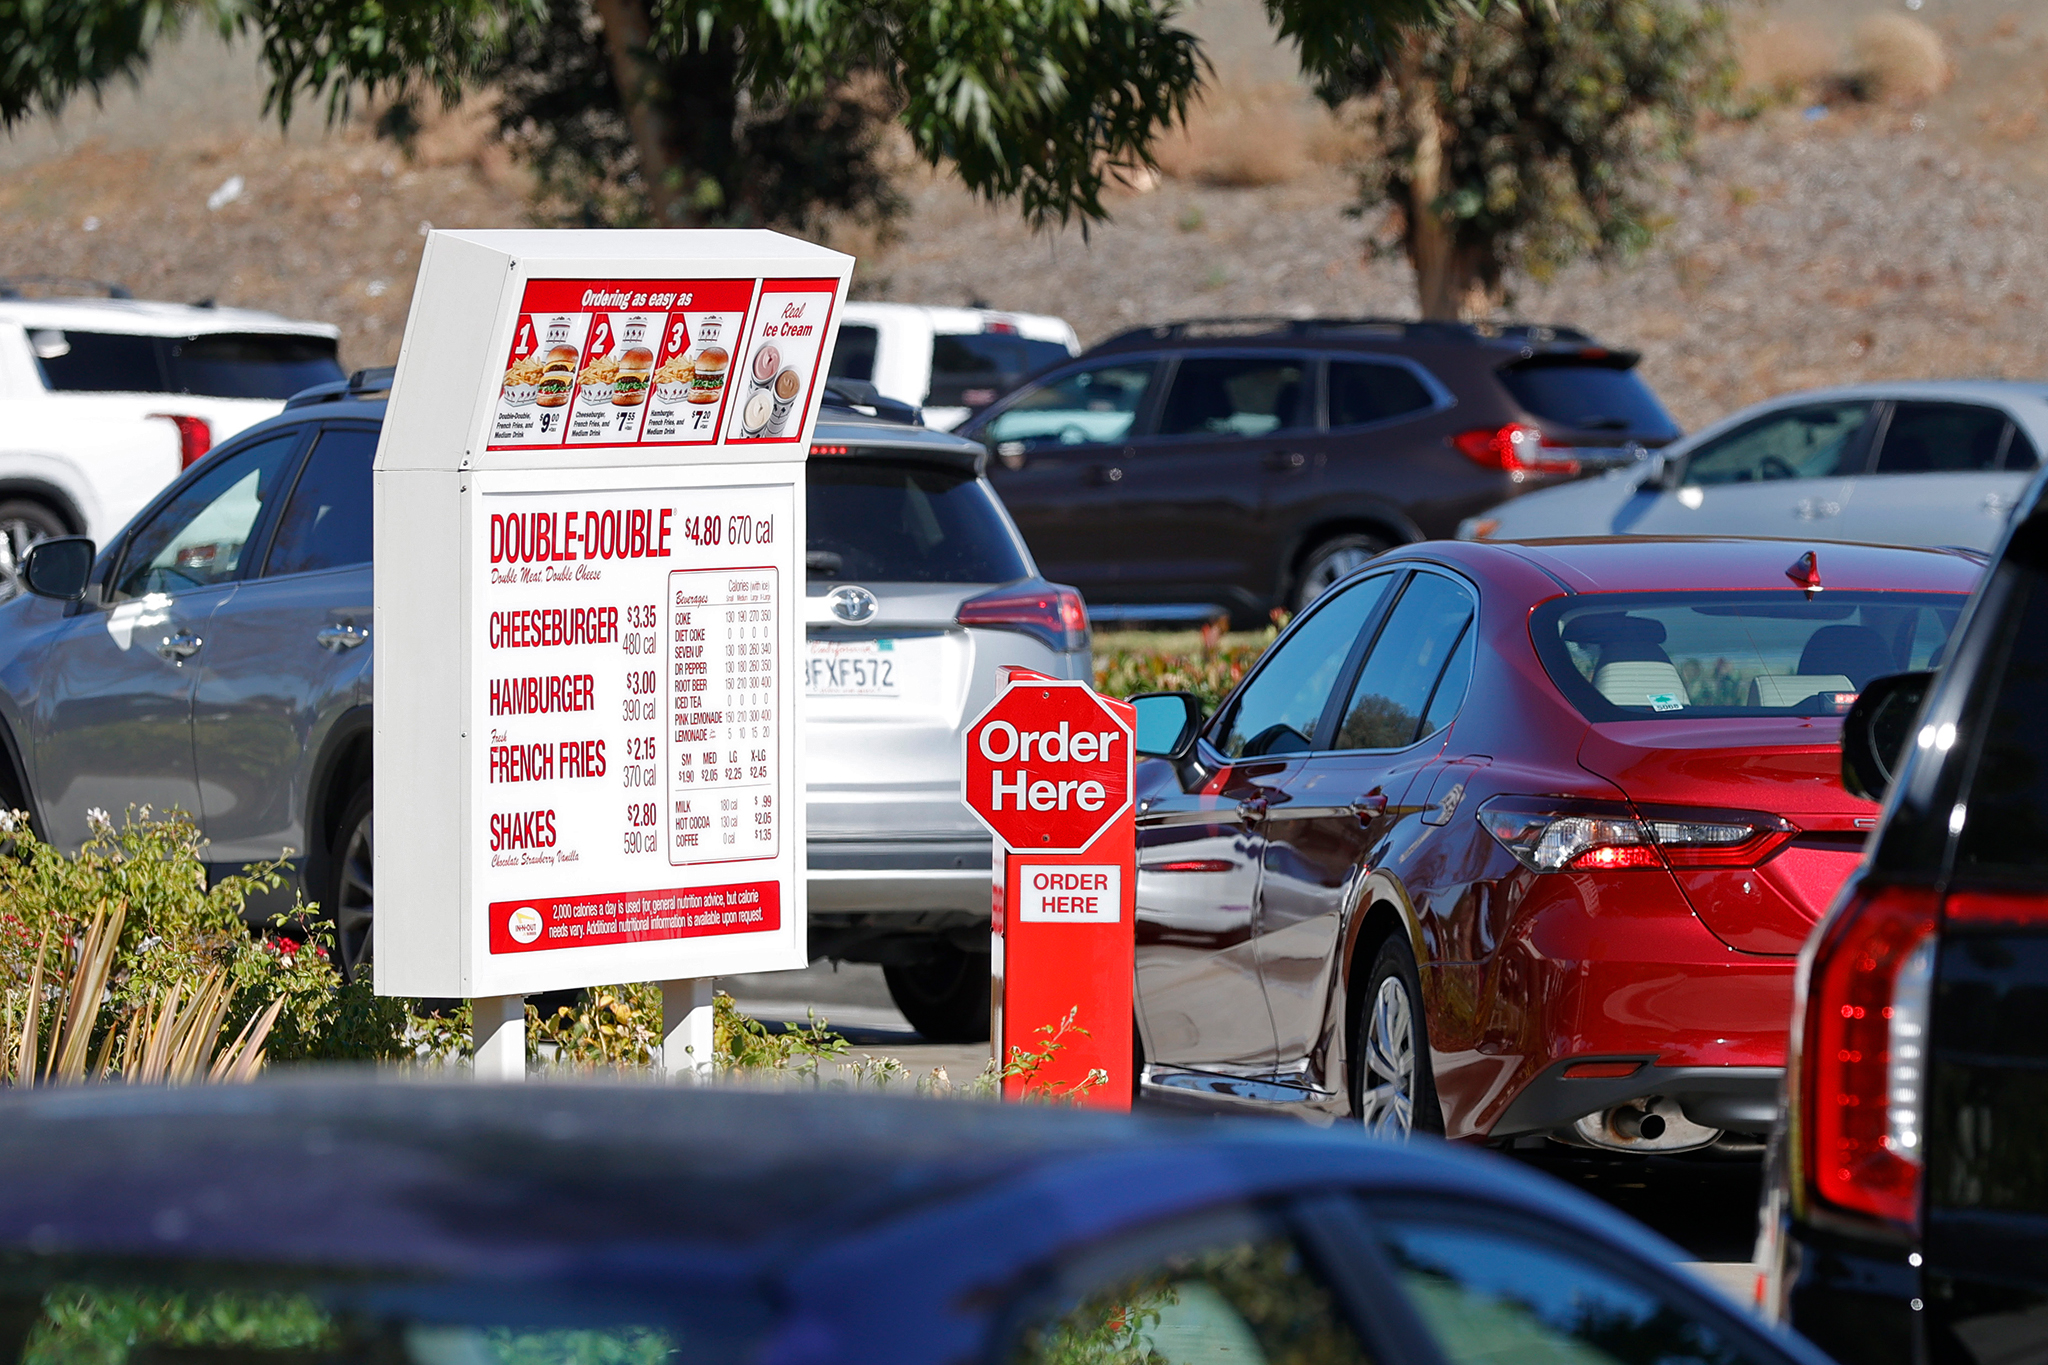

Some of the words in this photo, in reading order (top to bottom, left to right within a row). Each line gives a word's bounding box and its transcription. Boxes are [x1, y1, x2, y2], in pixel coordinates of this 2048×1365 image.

[581, 289, 633, 310] Ordering
[631, 293, 647, 306] as
[648, 293, 677, 310] easy
[677, 293, 693, 306] as
[781, 302, 806, 319] Real
[515, 323, 531, 354] 1
[590, 322, 609, 353] 2
[667, 322, 684, 353] 3
[762, 322, 778, 337] Ice
[780, 322, 813, 337] Cream
[575, 411, 605, 419] Cheeseburger,
[650, 410, 674, 418] Hamburger,
[512, 422, 524, 430] Fries,
[490, 508, 672, 563] DOUBLE-DOUBLE
[685, 515, 721, 546] $4.80
[728, 515, 752, 545] 670
[755, 514, 773, 544] cal
[491, 568, 517, 584] Double
[546, 565, 573, 582] Double
[575, 564, 601, 581] Cheese
[728, 579, 749, 592] Calories
[676, 590, 708, 608] Beverages
[675, 612, 691, 625] COKE
[749, 610, 759, 622] 270
[761, 609, 771, 621] 350
[490, 606, 618, 649] CHEESEBURGER
[627, 605, 656, 628] $3.35
[675, 629, 688, 642] DIET
[689, 628, 705, 641] COKE
[622, 632, 641, 655] 480
[643, 632, 657, 654] cal
[675, 646, 694, 659] SEVEN
[695, 645, 703, 658] UP
[761, 643, 771, 655] 340
[675, 663, 683, 675] DR
[685, 662, 707, 675] PEPPER
[761, 659, 771, 671] 350
[490, 674, 594, 716] HAMBURGER
[627, 670, 656, 694] $3.00
[675, 679, 691, 692] ROOT
[692, 679, 707, 691] BEER
[749, 676, 759, 689] 300
[761, 676, 771, 688] 400
[622, 699, 640, 721] 390
[643, 697, 656, 720] cal
[675, 696, 688, 709] ICED
[689, 696, 702, 708] TEA
[675, 713, 688, 726] PINK
[690, 711, 722, 725] LEMONADE
[749, 710, 759, 722] 300
[761, 709, 771, 721] 400
[491, 729, 507, 744] Fresh
[675, 728, 707, 742] LEMONADE
[739, 727, 745, 739] 10
[763, 726, 770, 738] 20
[978, 720, 1119, 762] Order
[490, 743, 553, 783] FRENCH
[560, 739, 606, 779] FRIES
[627, 737, 656, 760] $2.15
[681, 753, 691, 766] SM
[703, 751, 717, 764] MED
[729, 750, 738, 763] LG
[751, 749, 766, 762] X-LG
[623, 765, 641, 788] 370
[643, 763, 656, 786] cal
[701, 768, 718, 781] $2.05
[725, 767, 742, 780] $2.25
[750, 766, 767, 778] $2.45
[991, 770, 1106, 812] Here
[675, 800, 691, 813] MILK
[490, 809, 556, 851] SHAKES
[628, 803, 656, 826] $2.80
[675, 817, 688, 830] HOT
[689, 816, 710, 829] COCOA
[754, 812, 772, 824] $2.05
[624, 831, 642, 854] 590
[644, 830, 657, 852] cal
[676, 833, 698, 847] COFFEE
[491, 854, 519, 868] Chocolate
[521, 851, 554, 867] Strawberry
[557, 850, 579, 863] Vanilla
[1033, 873, 1108, 891] ORDER
[552, 904, 571, 921] 2,000
[572, 902, 598, 918] calories
[599, 903, 604, 915] a
[605, 900, 616, 918] day
[618, 899, 624, 914] is
[625, 898, 641, 914] used
[652, 895, 675, 914] general
[677, 894, 702, 909] nutrition
[704, 892, 726, 908] advice,
[726, 891, 737, 905] but
[738, 889, 759, 904] calorie
[1042, 896, 1098, 913] HERE
[548, 923, 568, 938] needs
[569, 924, 585, 939] vary.
[586, 919, 617, 935] Additional
[618, 916, 650, 932] nutritional
[650, 914, 686, 930] information
[687, 913, 693, 927] is
[694, 910, 720, 926] available
[722, 911, 737, 926] upon
[738, 907, 763, 925] request.
